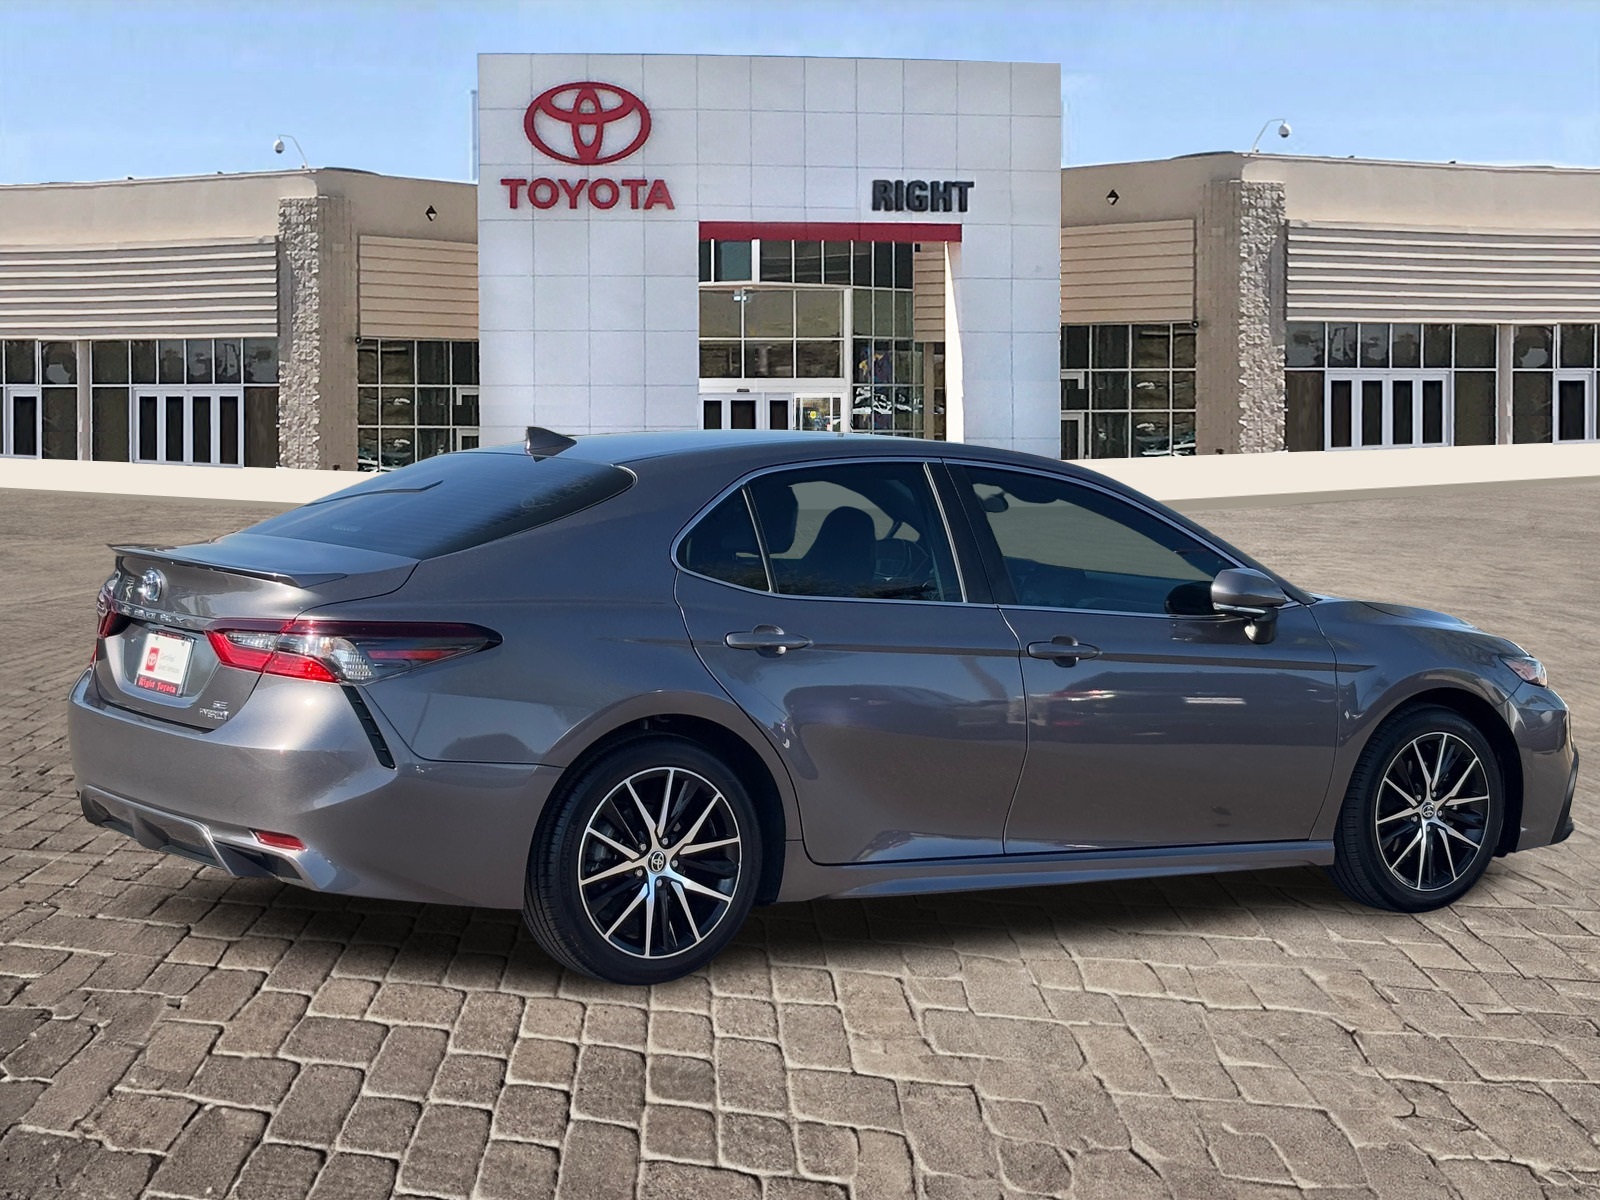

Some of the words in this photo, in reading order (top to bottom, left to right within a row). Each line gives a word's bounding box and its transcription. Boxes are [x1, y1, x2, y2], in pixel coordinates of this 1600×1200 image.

[500, 178, 674, 210] TOYOTA
[871, 180, 975, 213] RIGHT
[139, 676, 156, 688] Right
[157, 682, 176, 693] Toyota
